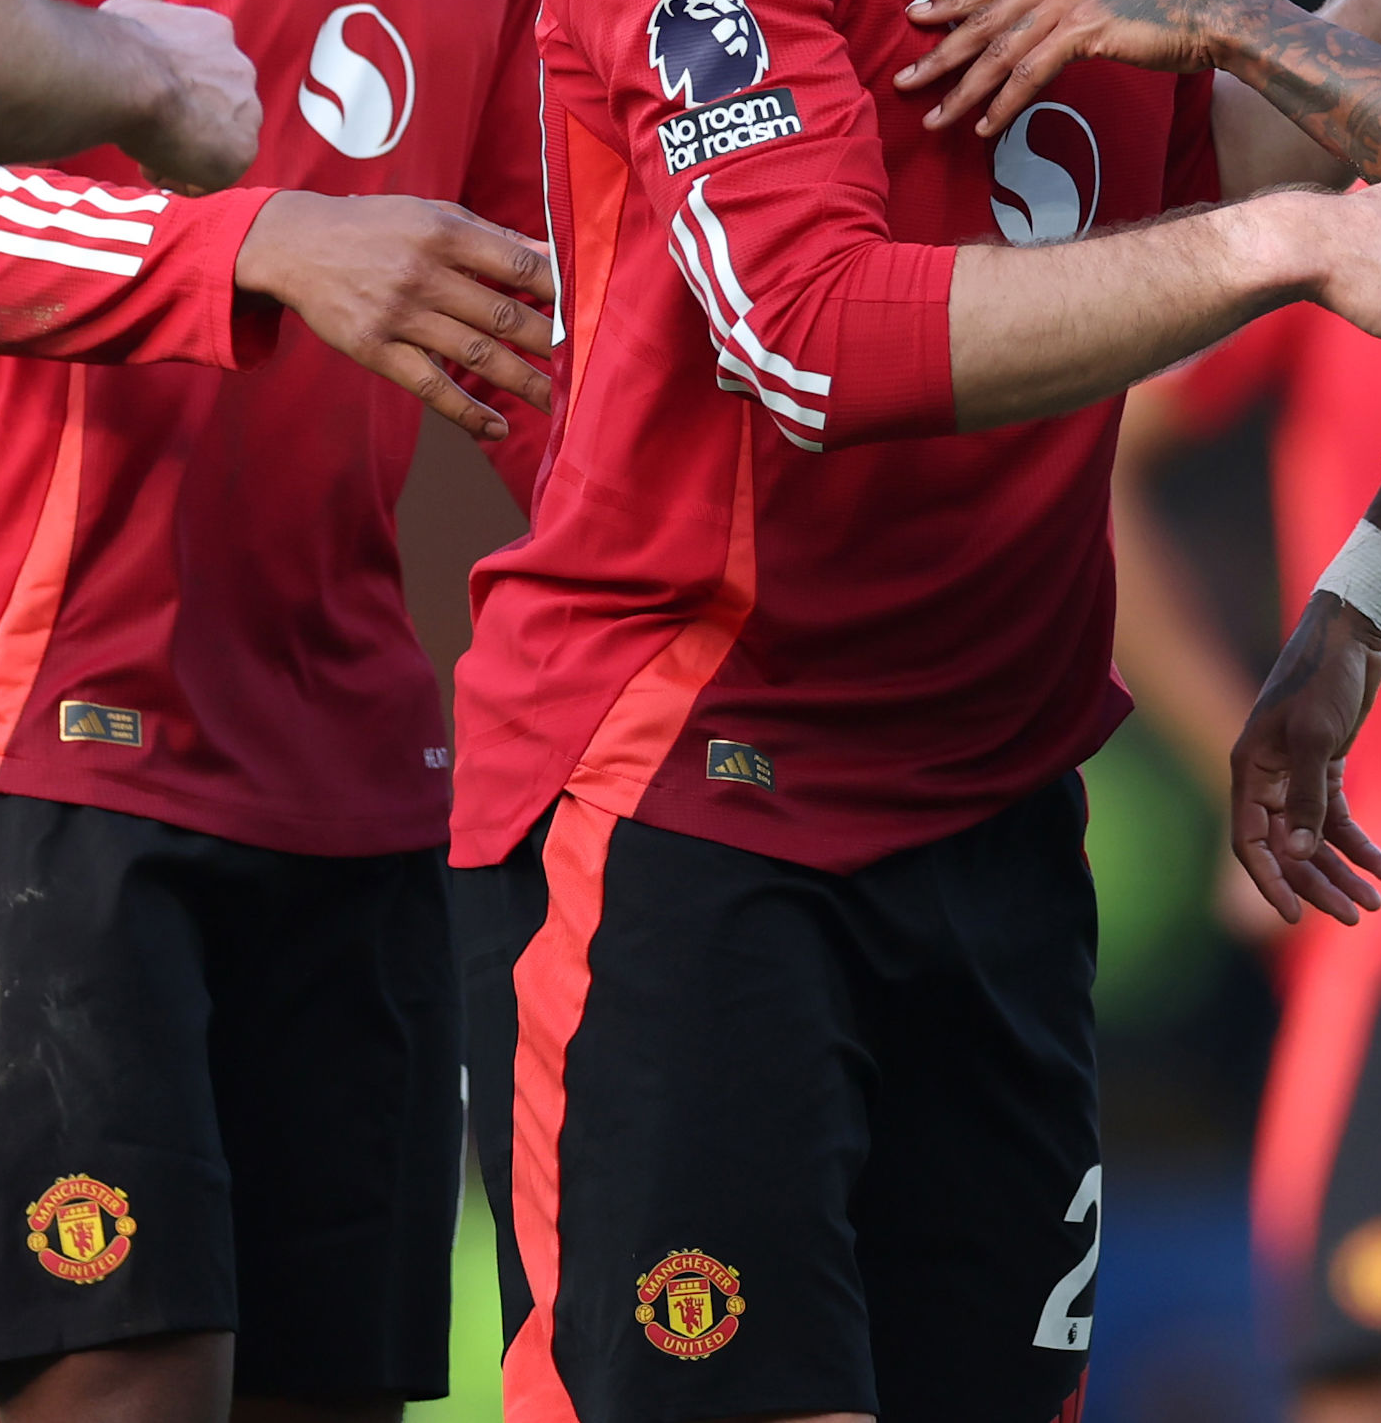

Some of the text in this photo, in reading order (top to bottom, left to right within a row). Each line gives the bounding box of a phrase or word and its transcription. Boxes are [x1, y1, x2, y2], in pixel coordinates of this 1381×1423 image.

[658, 96, 782, 152] No room
[665, 115, 802, 176] for racism
[35, 1183, 120, 1224] MANCHESTER
[58, 1253, 117, 1277] UNITED
[645, 1257, 732, 1296] MANCHESTER
[663, 1332, 724, 1353] UNITED
